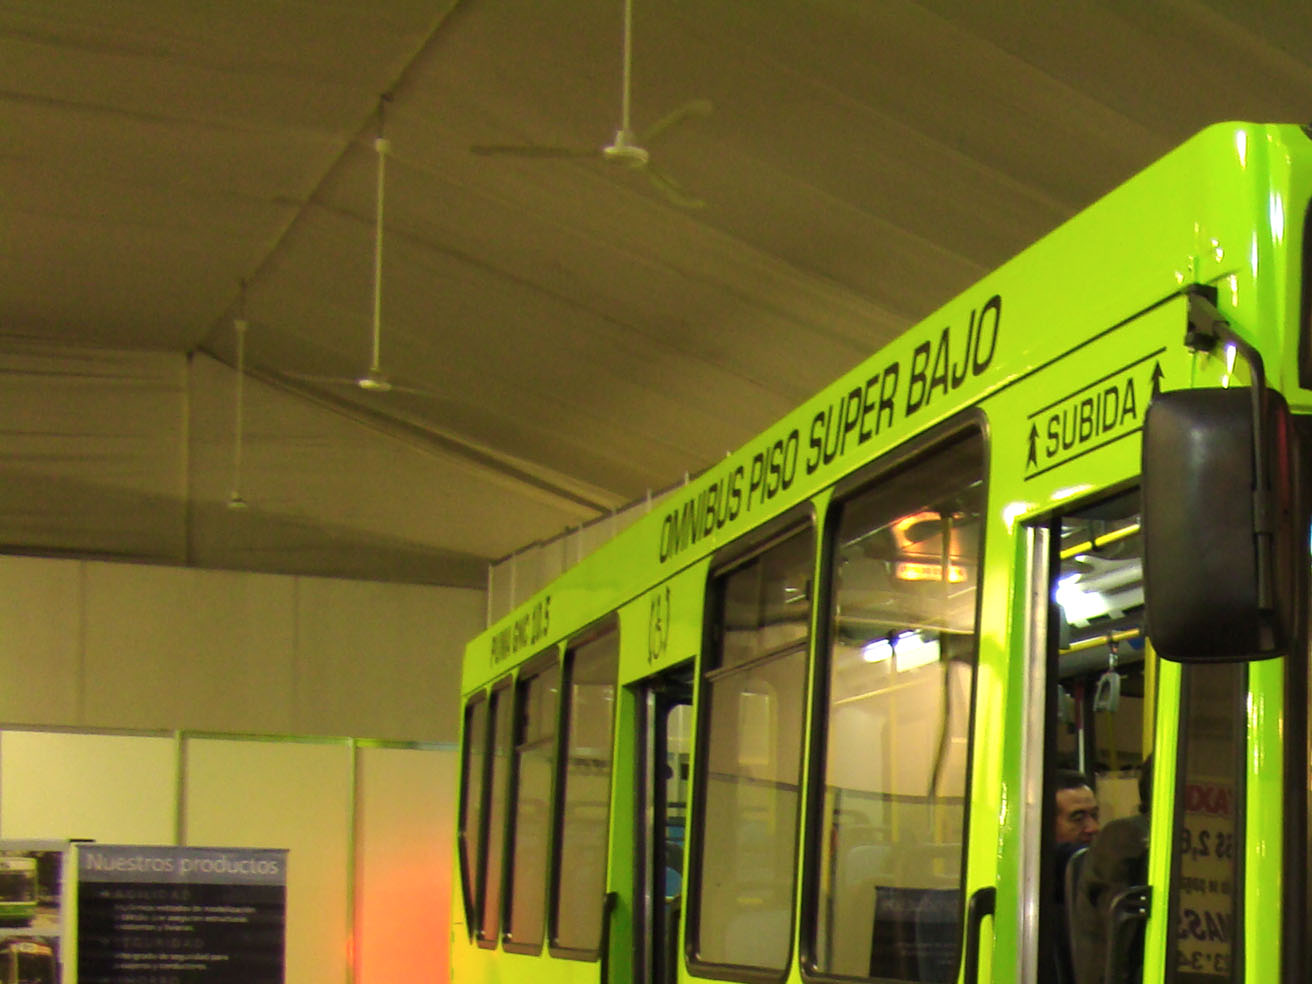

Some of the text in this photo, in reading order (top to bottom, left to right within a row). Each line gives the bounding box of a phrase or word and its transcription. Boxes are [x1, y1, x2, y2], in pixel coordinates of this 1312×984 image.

[659, 294, 1001, 564] OMNIBUS PISO SUPER BAJO
[1046, 377, 1137, 458] SUBIDA
[86, 854, 279, 877] Nuestros productos
